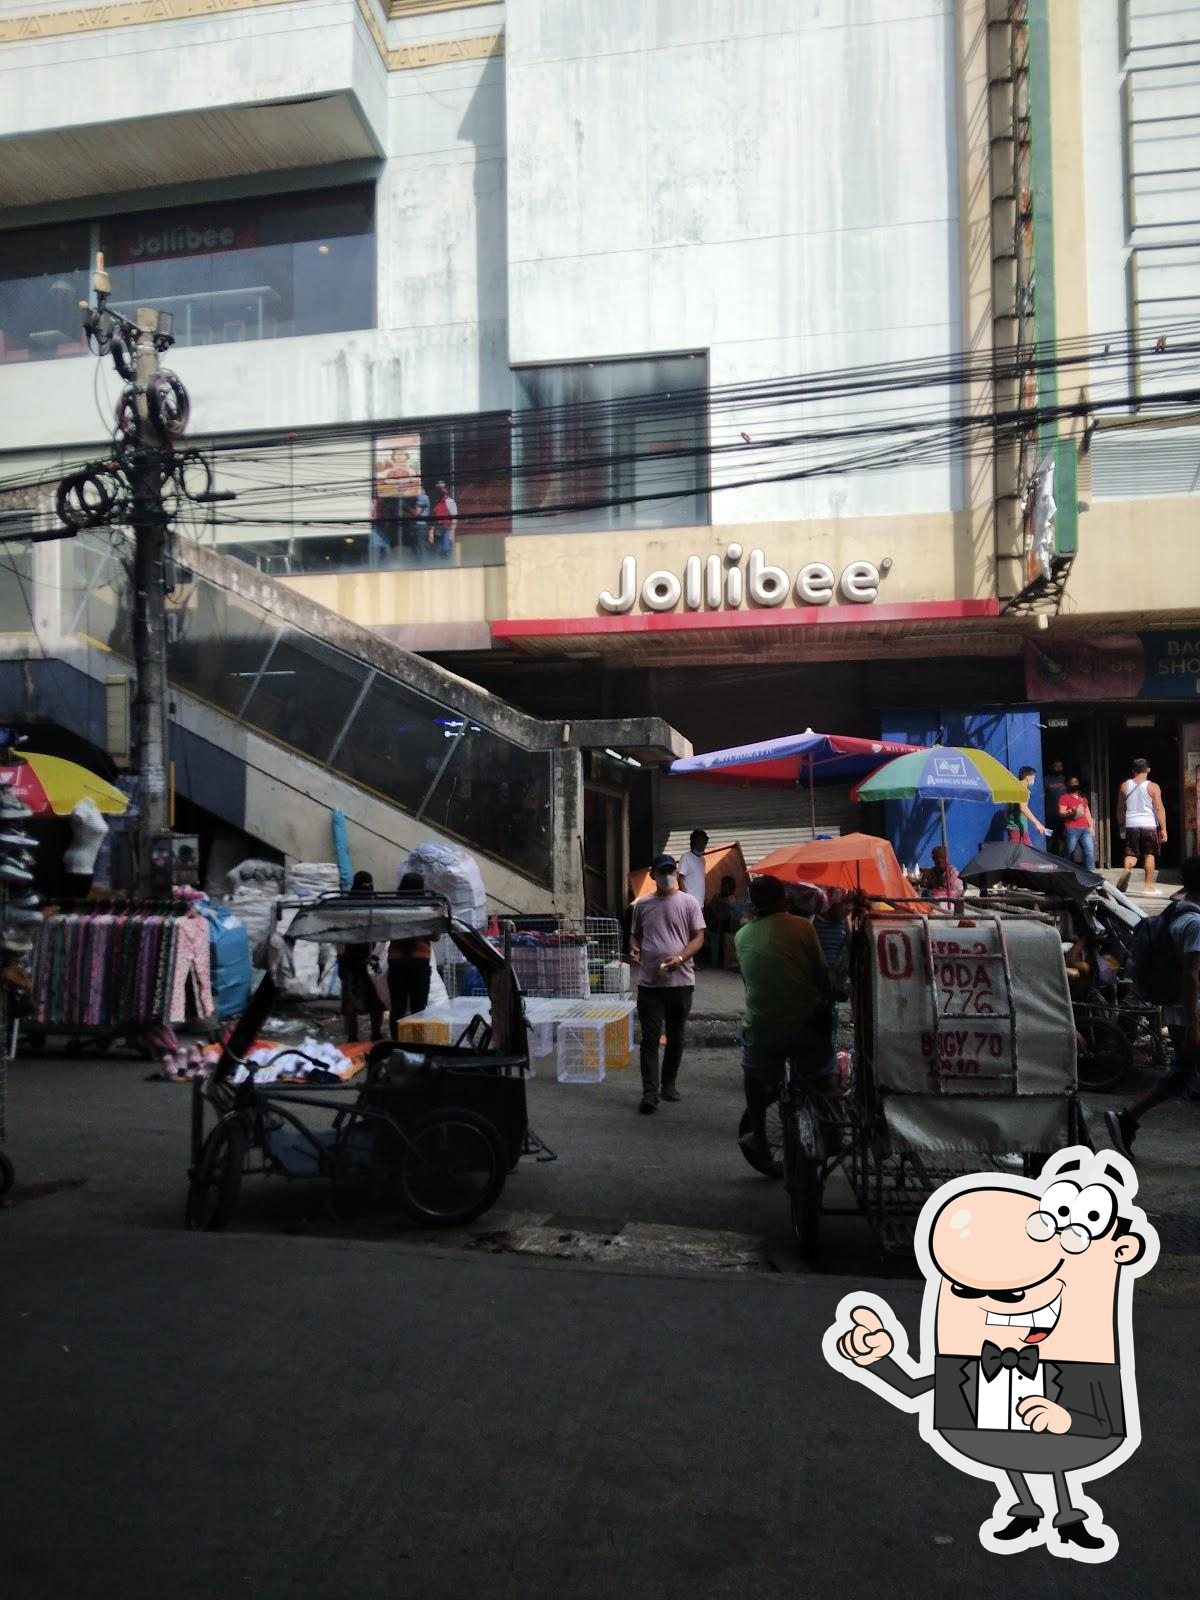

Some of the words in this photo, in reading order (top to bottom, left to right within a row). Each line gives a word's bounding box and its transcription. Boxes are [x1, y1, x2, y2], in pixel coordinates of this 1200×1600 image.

[130, 224, 234, 256] Jollibee
[599, 542, 881, 612] Jollibee
[941, 989, 994, 1014] 776
[973, 1030, 1003, 1058] 70
